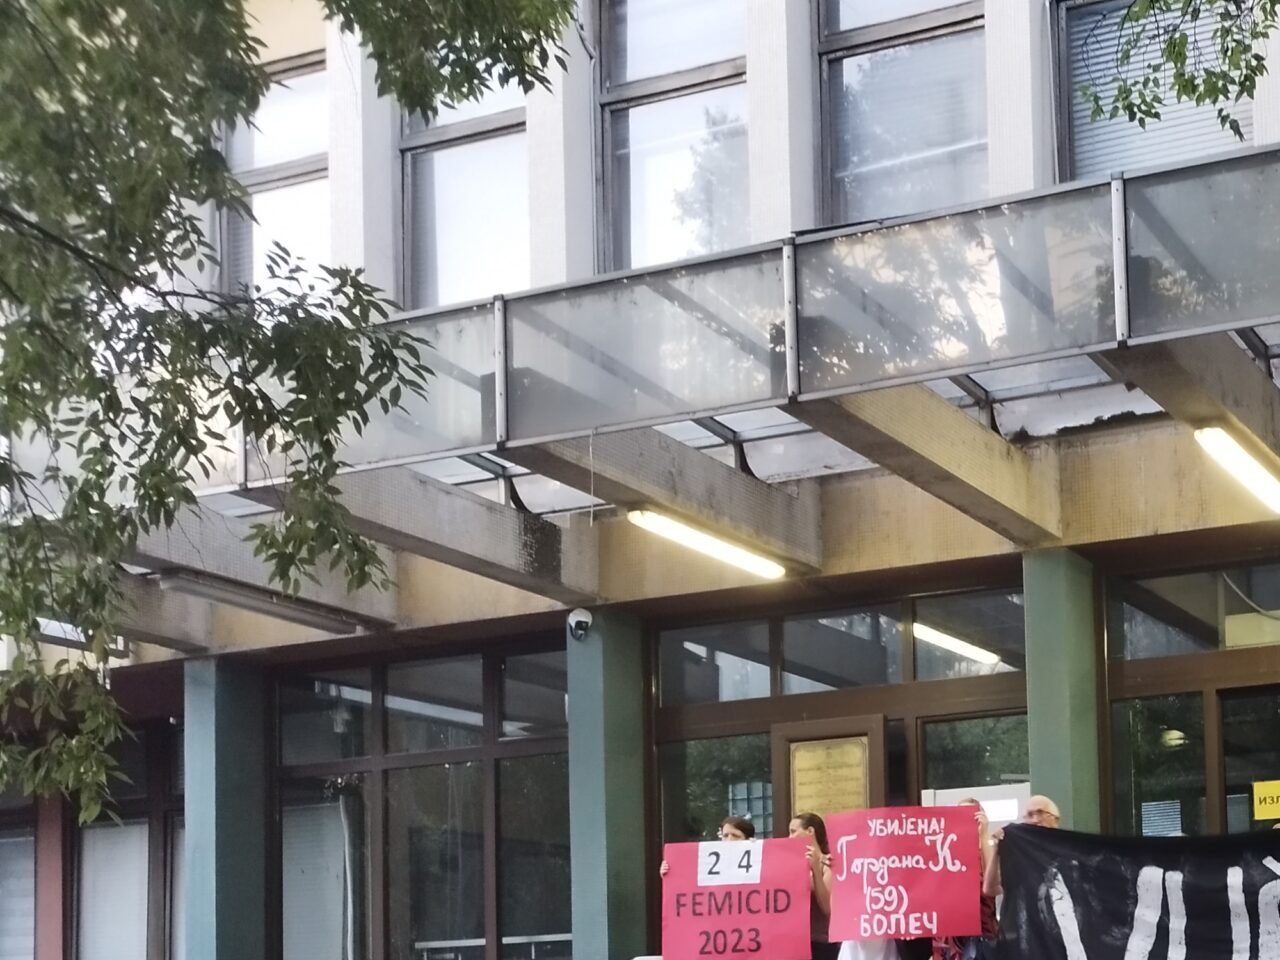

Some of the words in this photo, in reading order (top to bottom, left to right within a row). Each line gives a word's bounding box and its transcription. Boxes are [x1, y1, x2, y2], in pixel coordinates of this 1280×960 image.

[867, 813, 945, 837] УБИЈЕНА!
[924, 832, 967, 872] К.
[675, 888, 792, 917] FEMICID
[865, 885, 909, 915] (59)
[860, 911, 938, 938] БОЛЕЧ
[698, 927, 763, 956] 2023
